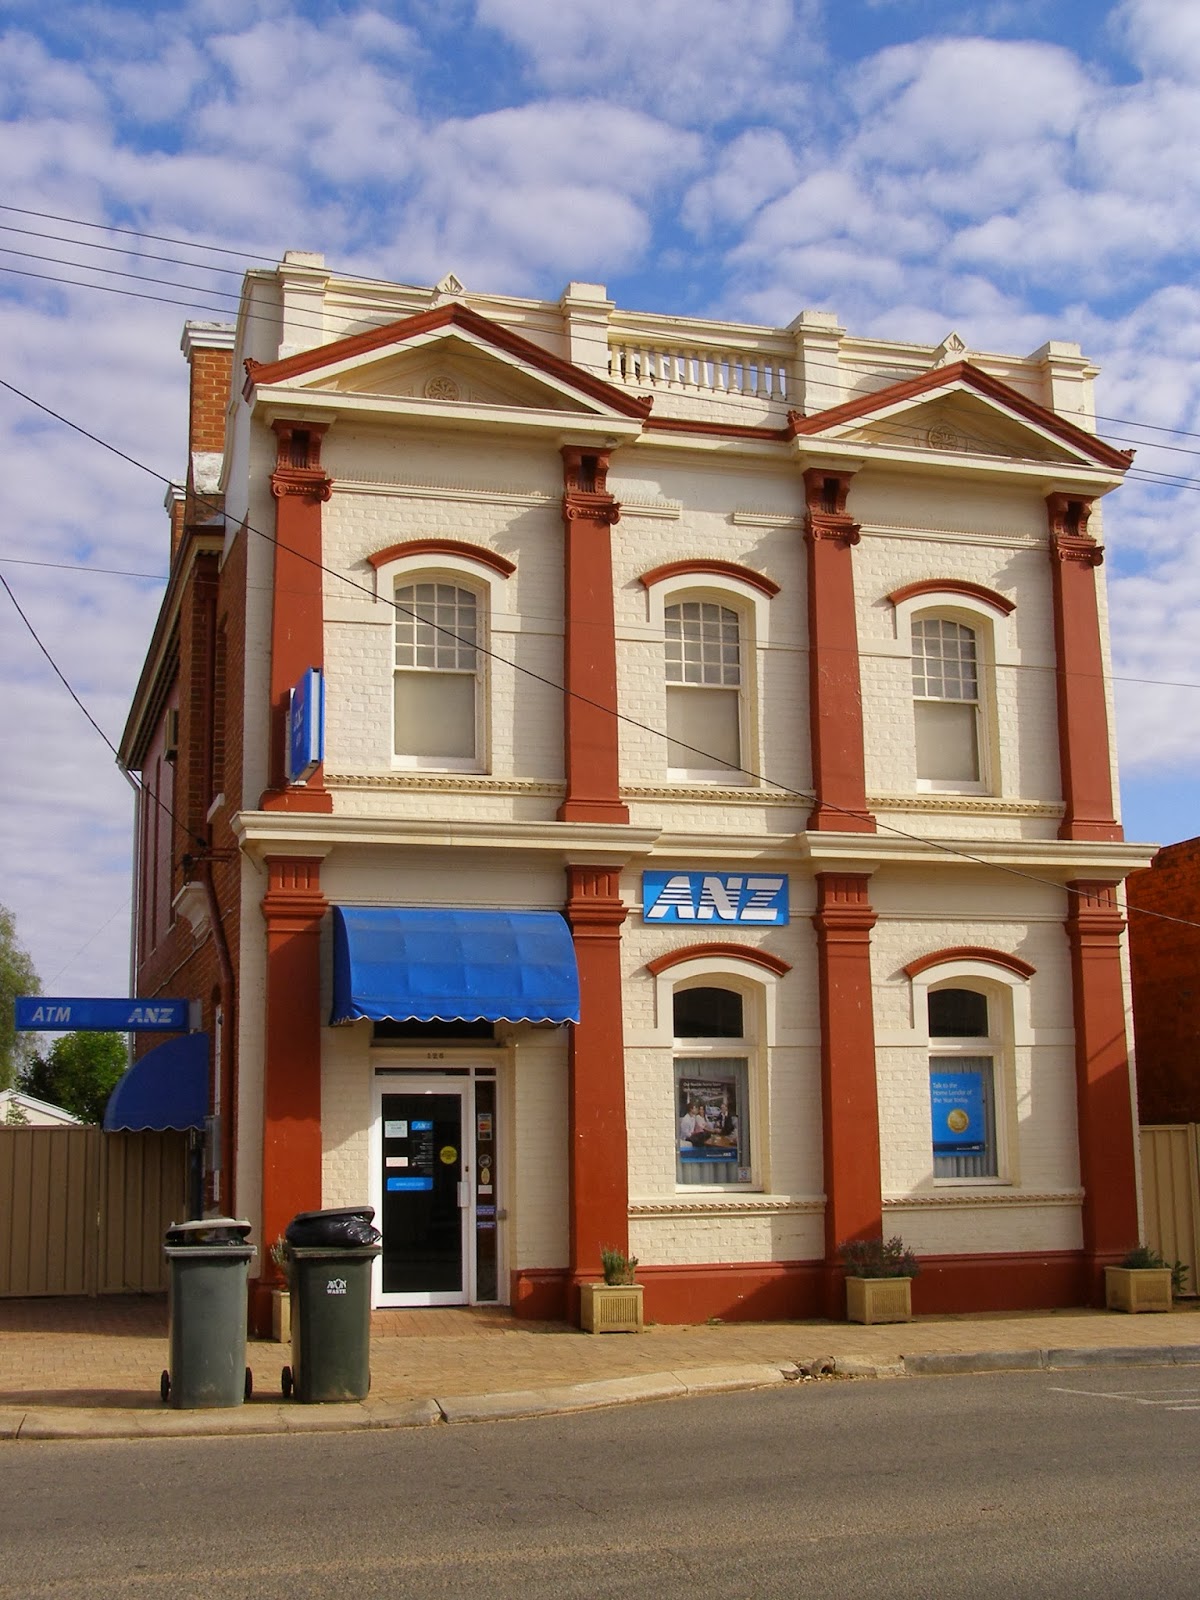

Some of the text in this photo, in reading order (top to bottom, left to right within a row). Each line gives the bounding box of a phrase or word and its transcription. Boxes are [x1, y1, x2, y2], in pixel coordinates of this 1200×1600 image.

[647, 875, 784, 921] ANZ
[32, 1007, 174, 1023] ATM ANZ
